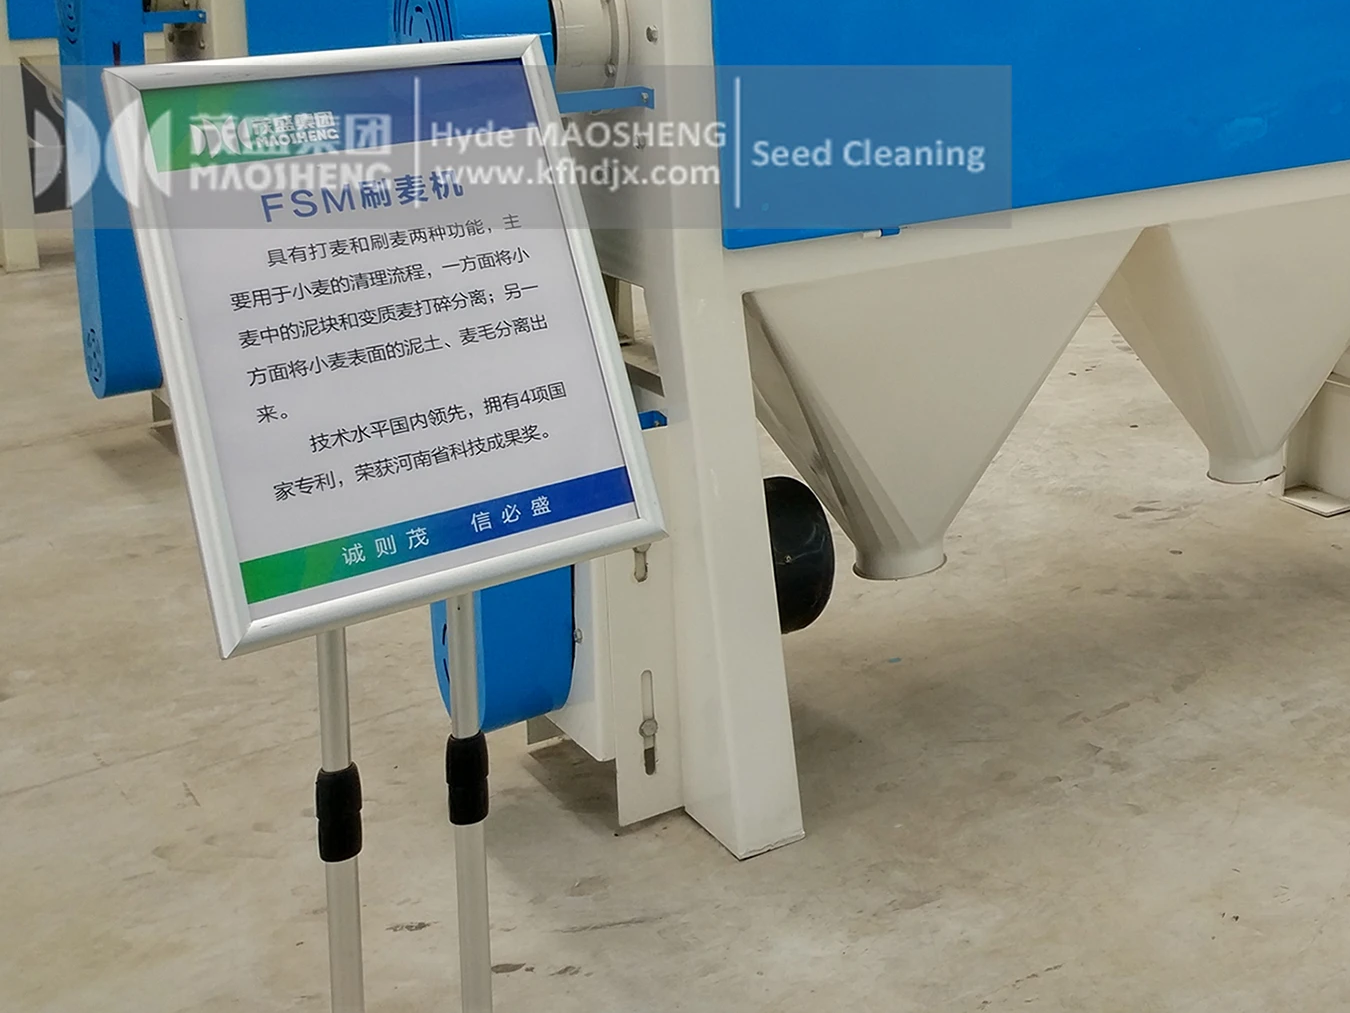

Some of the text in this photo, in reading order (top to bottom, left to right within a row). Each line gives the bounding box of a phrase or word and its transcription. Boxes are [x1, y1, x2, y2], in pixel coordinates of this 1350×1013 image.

[259, 169, 465, 223] FSM刷麦机
[255, 403, 288, 425] 来。
[341, 495, 552, 567] 诚则茂 信必盛
